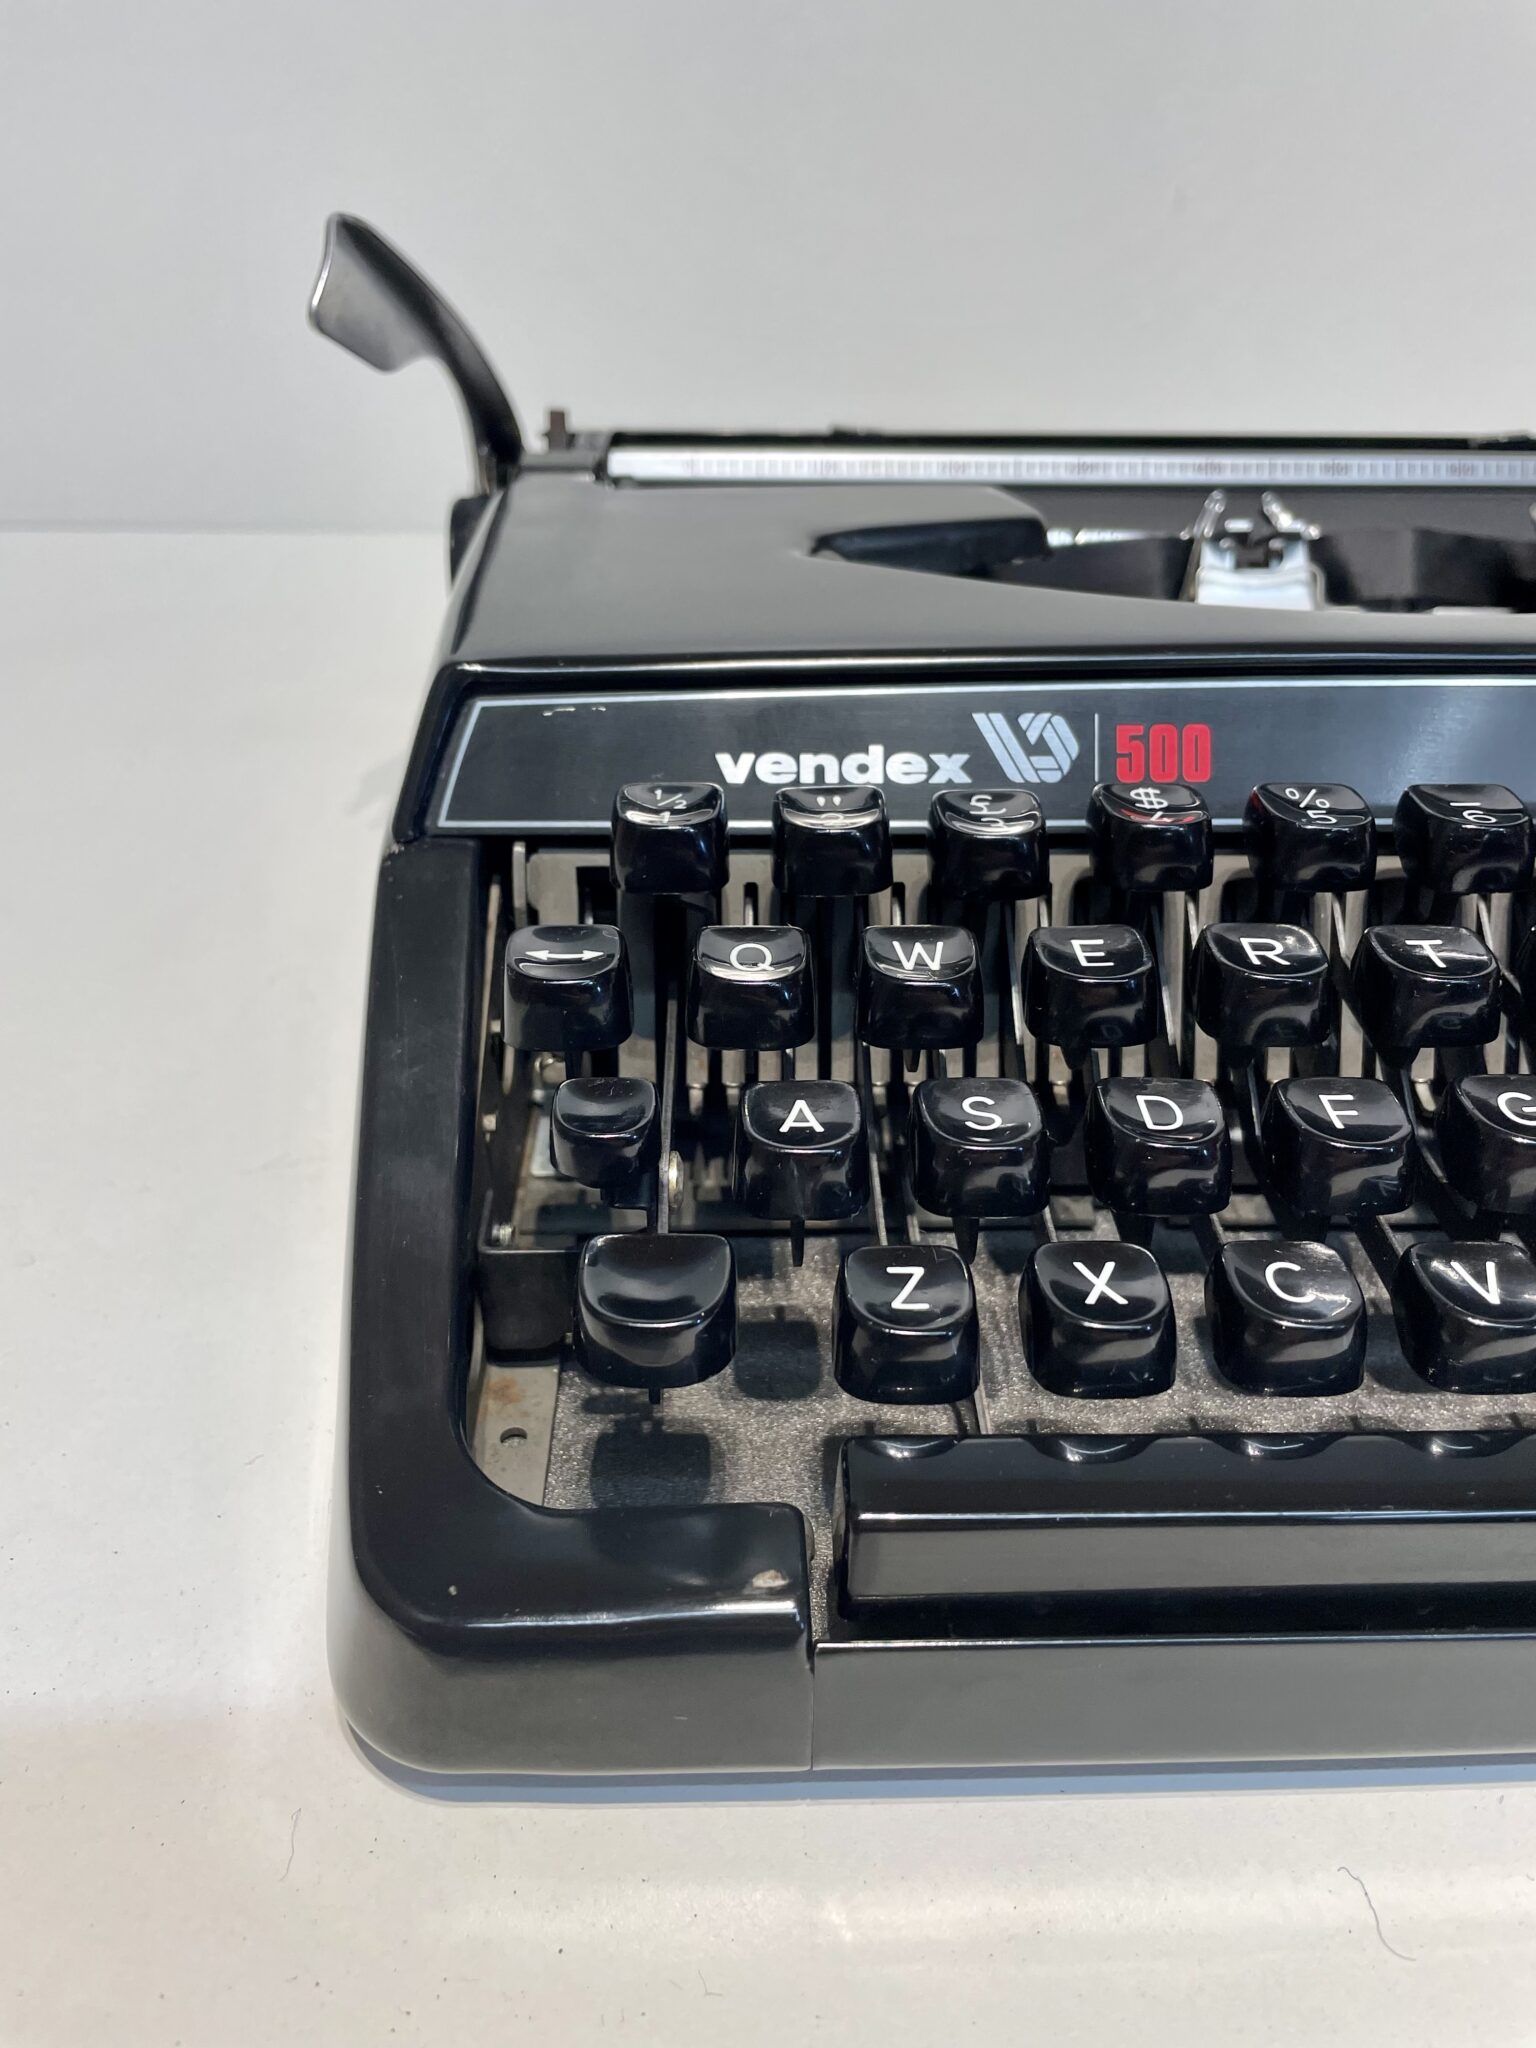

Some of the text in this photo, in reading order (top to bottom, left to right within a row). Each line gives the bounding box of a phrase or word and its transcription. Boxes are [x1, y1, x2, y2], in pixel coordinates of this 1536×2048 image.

[715, 744, 974, 785] vendex
[1116, 723, 1212, 783] 500
[1129, 787, 1168, 809] $
[1285, 788, 1330, 809] %
[1306, 810, 1337, 824] 5
[1462, 810, 1497, 823] 6
[729, 942, 775, 972] Q
[891, 940, 944, 971] W
[1070, 938, 1115, 967] E
[1239, 937, 1291, 966] R
[1405, 938, 1447, 968] T
[778, 1099, 825, 1133] A
[960, 1096, 1002, 1131] S
[1135, 1094, 1184, 1130] D
[1317, 1093, 1360, 1129] F
[1497, 1091, 1536, 1126] G
[886, 1266, 930, 1310] Z
[1072, 1261, 1129, 1305] X
[1265, 1261, 1316, 1303] C
[1450, 1261, 1501, 1305] V
